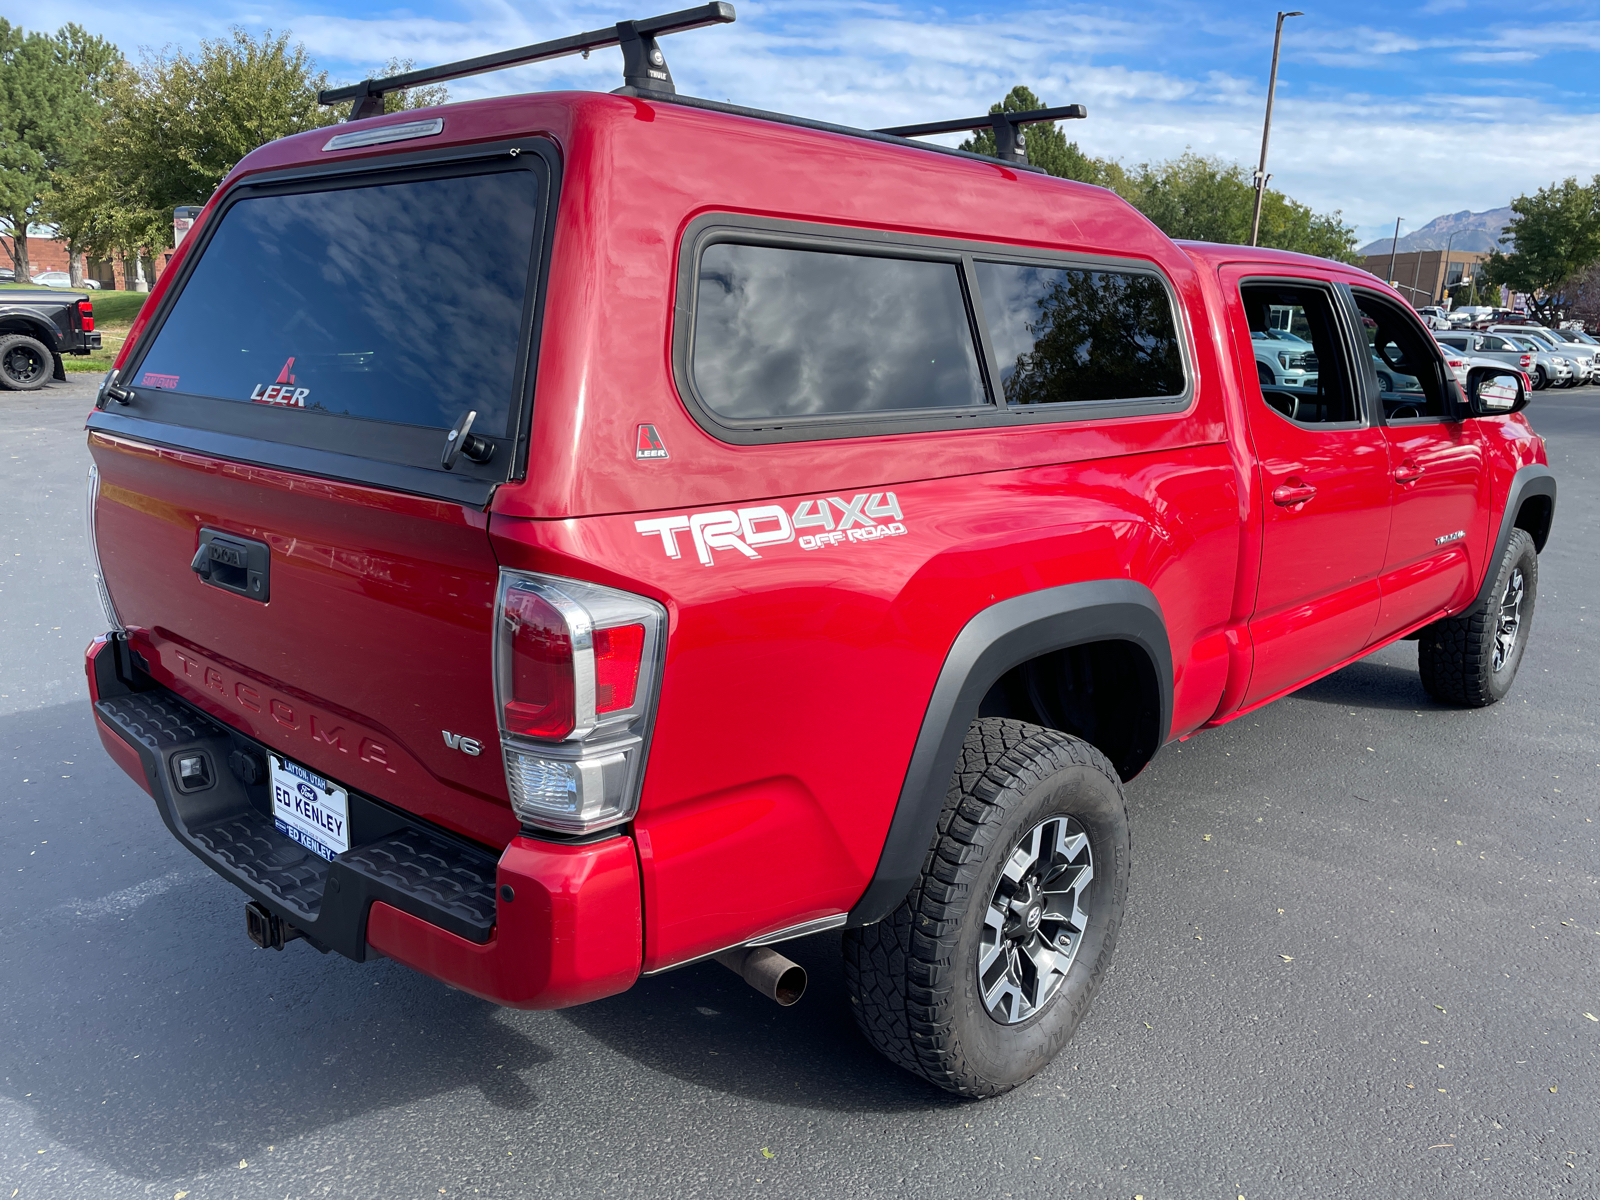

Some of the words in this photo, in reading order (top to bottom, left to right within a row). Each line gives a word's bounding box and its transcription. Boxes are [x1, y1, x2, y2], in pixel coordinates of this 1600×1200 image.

[650, 70, 667, 80] THULE
[141, 376, 155, 386] SAM
[157, 378, 179, 389] EVANS
[250, 383, 310, 407] LEER
[638, 449, 666, 458] LEER
[634, 504, 796, 567] TRD
[792, 491, 904, 531] 4X4
[798, 530, 846, 551] OFF
[848, 522, 908, 543] ROAD
[209, 544, 241, 567] TOYOTA
[175, 649, 397, 774] TACOMA
[441, 729, 485, 757] V6
[284, 760, 309, 781] LAYTON,
[310, 774, 326, 789] UTAH
[300, 784, 315, 801] Ford
[276, 785, 291, 808] ED
[295, 795, 343, 837] KENLEY
[301, 833, 332, 862] KENLEY
[1111, 844, 1125, 907] BACK
